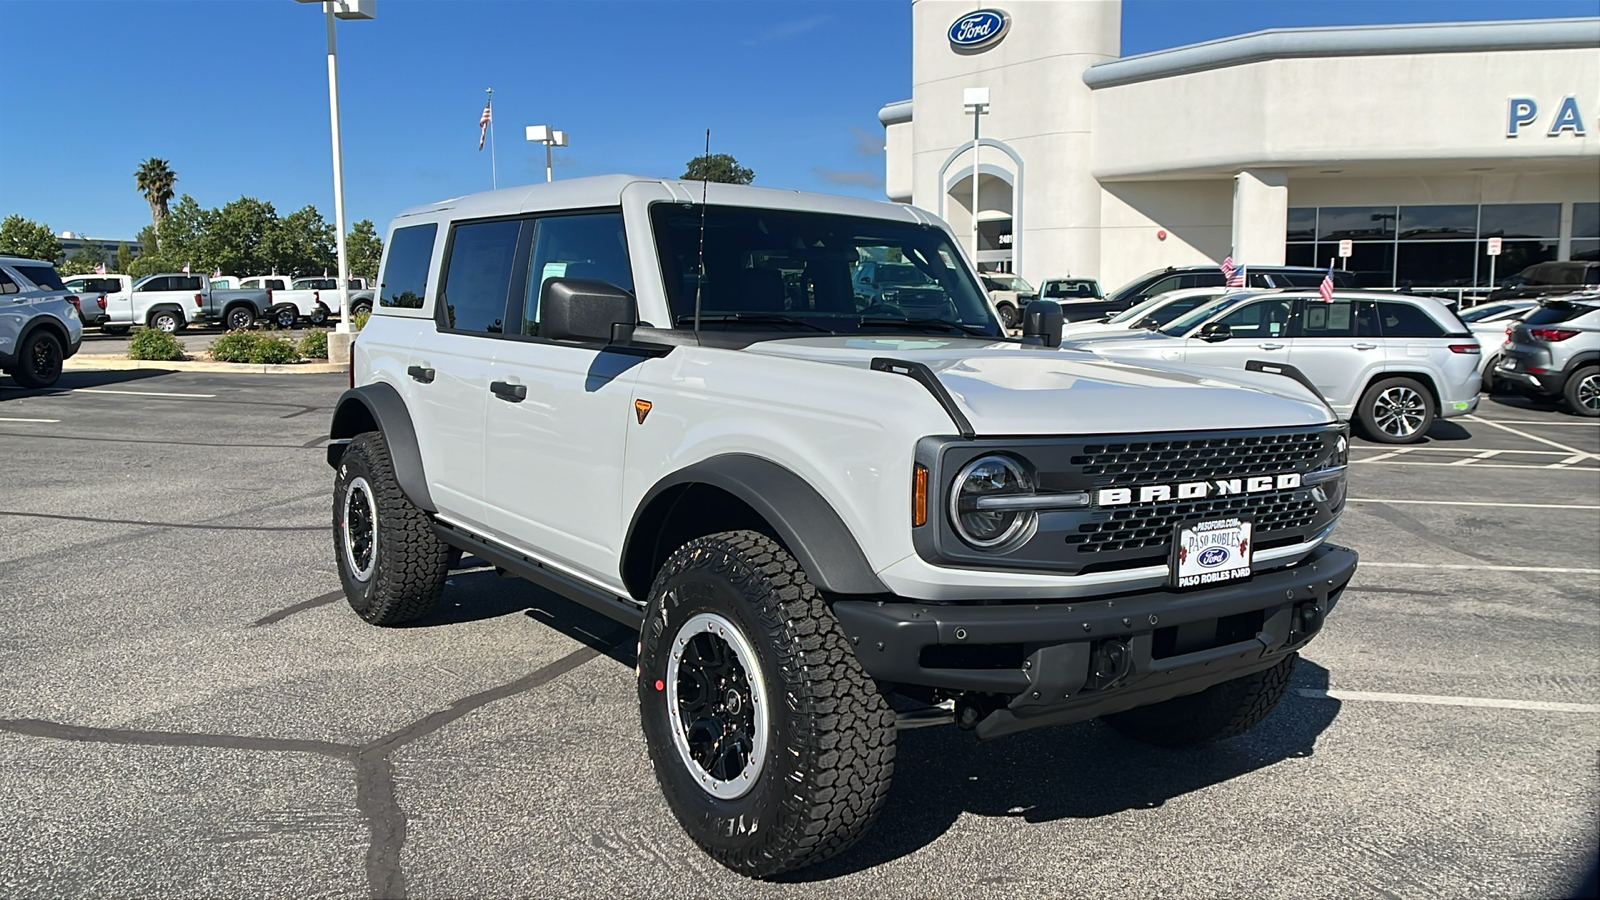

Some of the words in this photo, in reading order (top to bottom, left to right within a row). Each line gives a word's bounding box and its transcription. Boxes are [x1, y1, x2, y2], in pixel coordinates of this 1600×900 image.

[957, 16, 992, 41] Ford
[1099, 473, 1301, 506] BRONCO
[1188, 535, 1209, 554] PASO
[1211, 531, 1241, 549] ROBLES
[1203, 550, 1224, 565] Ford
[1179, 575, 1200, 588] PASO
[1201, 570, 1231, 584] ROBLES
